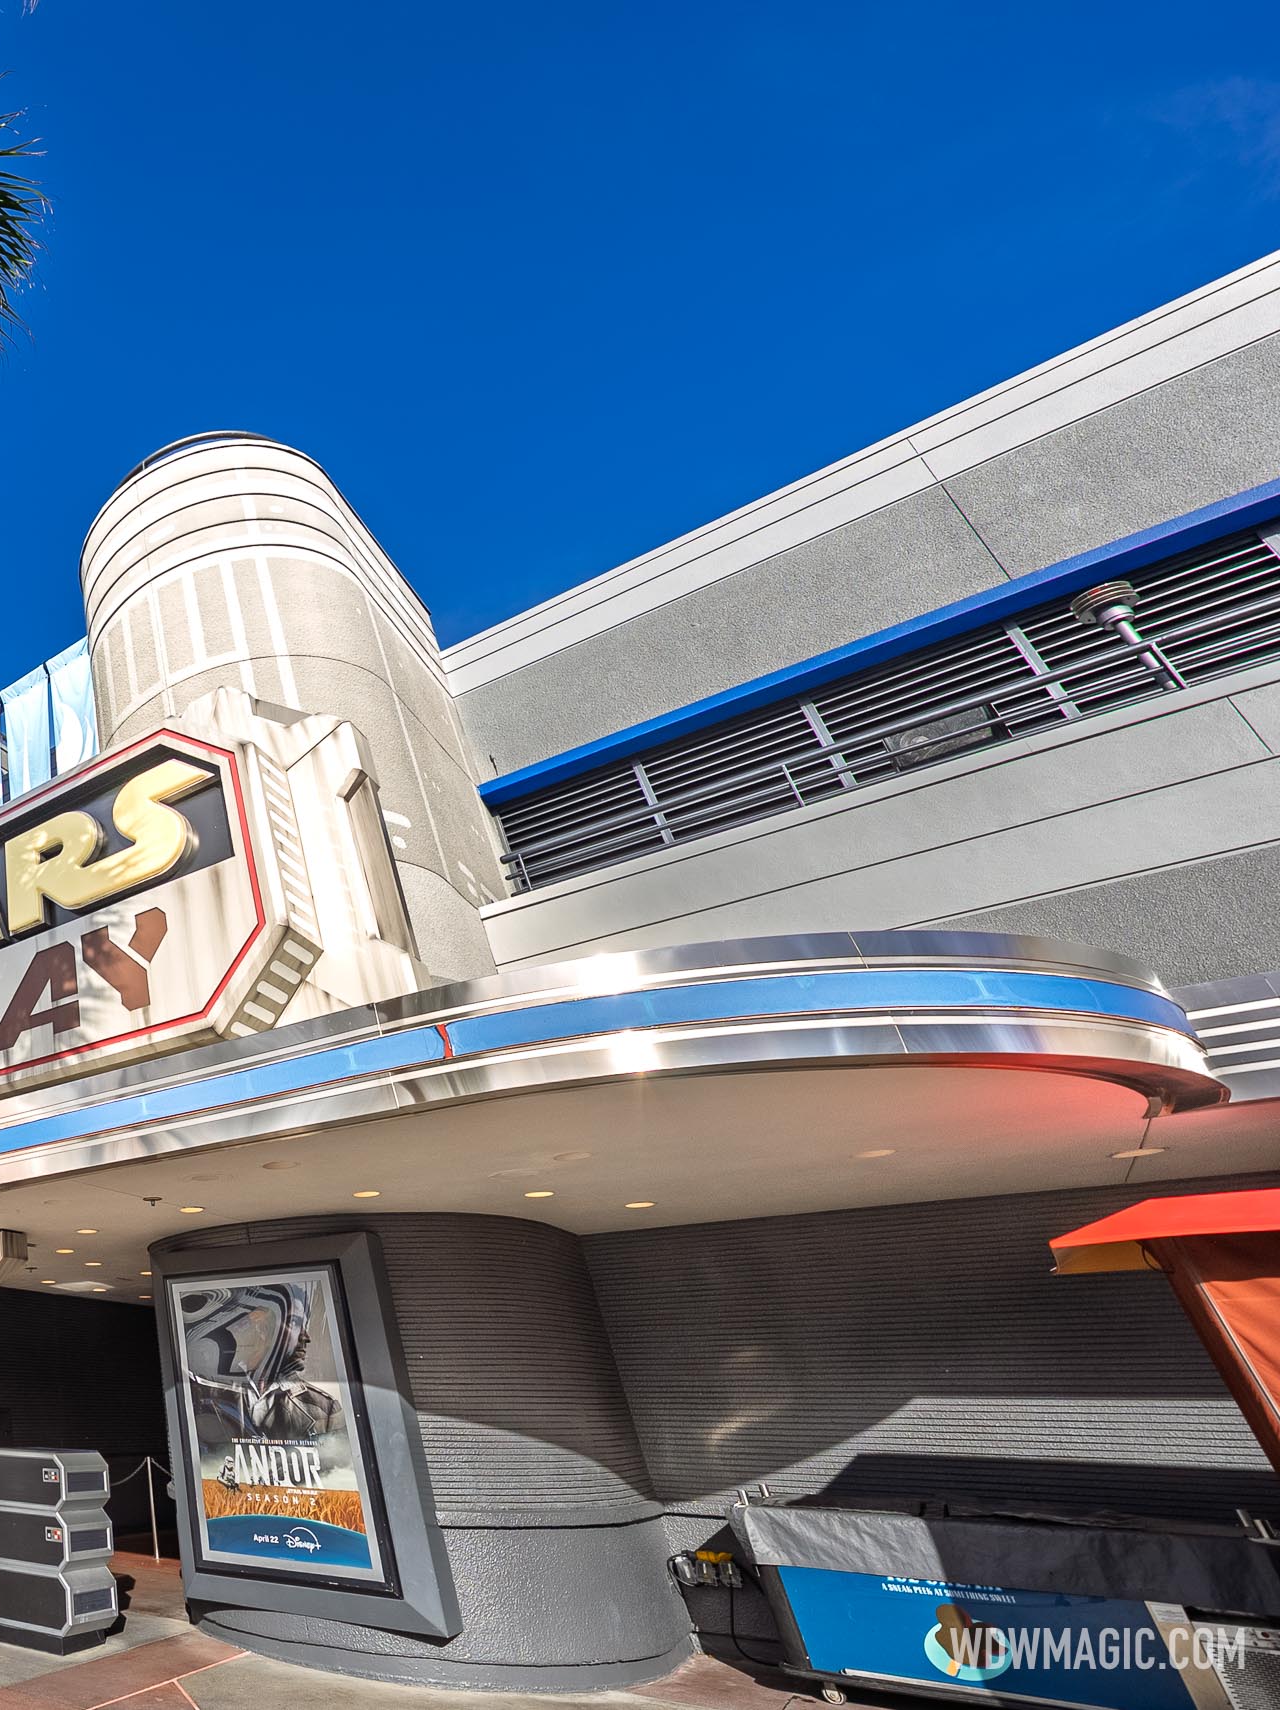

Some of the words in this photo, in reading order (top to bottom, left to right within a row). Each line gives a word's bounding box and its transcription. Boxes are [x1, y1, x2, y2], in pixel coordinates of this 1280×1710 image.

[234, 1444, 324, 1489] ANDOR
[247, 1493, 299, 1504] SEASON
[310, 1497, 316, 1506] 2
[253, 1533, 269, 1544] April
[270, 1535, 279, 1544] 22
